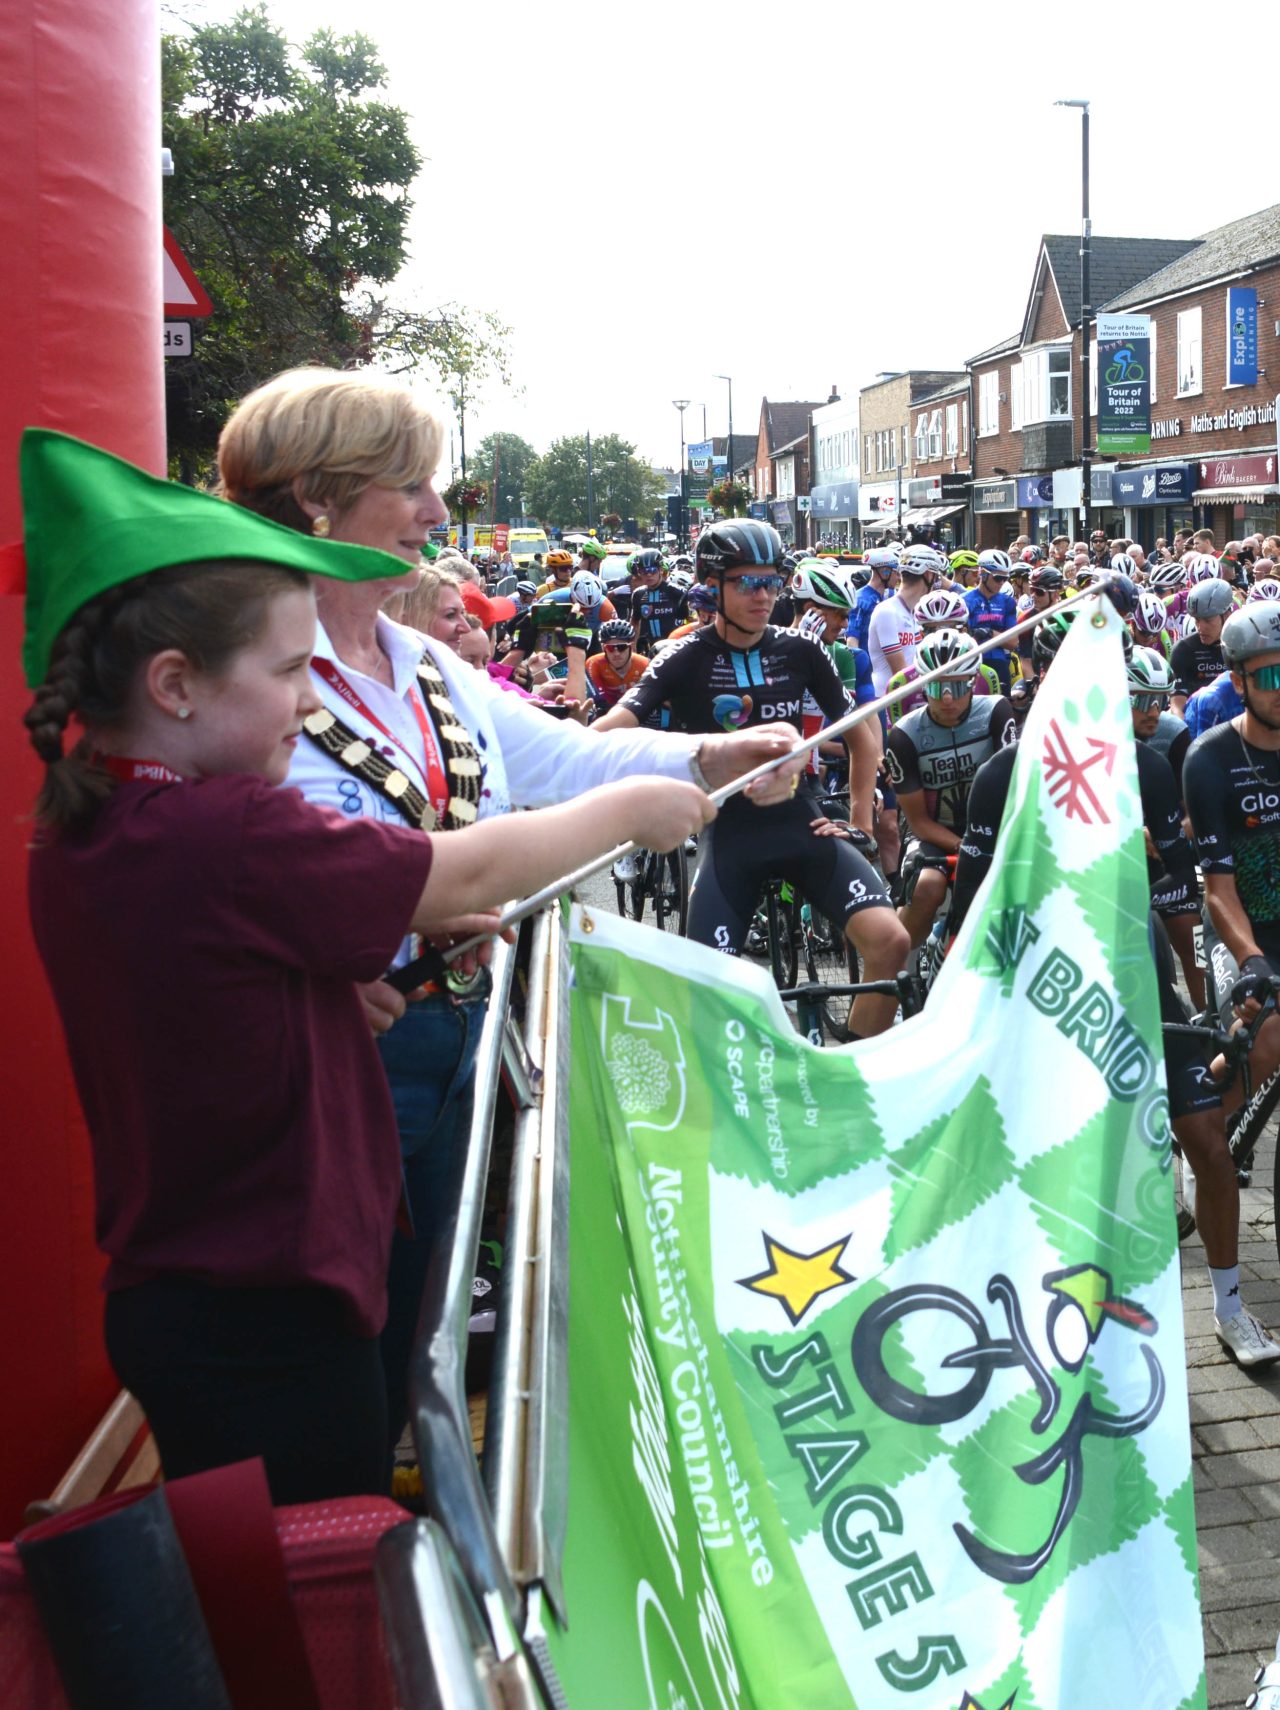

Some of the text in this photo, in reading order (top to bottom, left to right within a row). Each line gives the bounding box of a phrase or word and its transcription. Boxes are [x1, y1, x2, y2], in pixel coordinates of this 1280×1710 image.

[1233, 307, 1247, 366] Explore
[1107, 387, 1142, 396] Tour of
[1108, 397, 1140, 406] Britain
[1114, 407, 1134, 415] 2022
[1190, 413, 1213, 433] Maths
[1214, 410, 1228, 429] and
[1229, 404, 1257, 431] English
[1258, 400, 1276, 423] tuiti
[1158, 471, 1182, 486] Boots
[1235, 475, 1257, 484] BAKERY
[898, 632, 914, 646] GBR
[1197, 663, 1229, 672] Globa
[760, 700, 801, 719] DSM
[928, 751, 973, 772] Team
[922, 764, 978, 786] Qhube
[969, 824, 993, 837] LAS
[1198, 834, 1218, 846] LAS
[845, 894, 886, 910] SCOTT
[1025, 945, 1174, 1176] BRIDG
[726, 1045, 751, 1120] SCAPE
[670, 1359, 735, 1550] Council
[751, 1330, 968, 1693] STAGE 5
